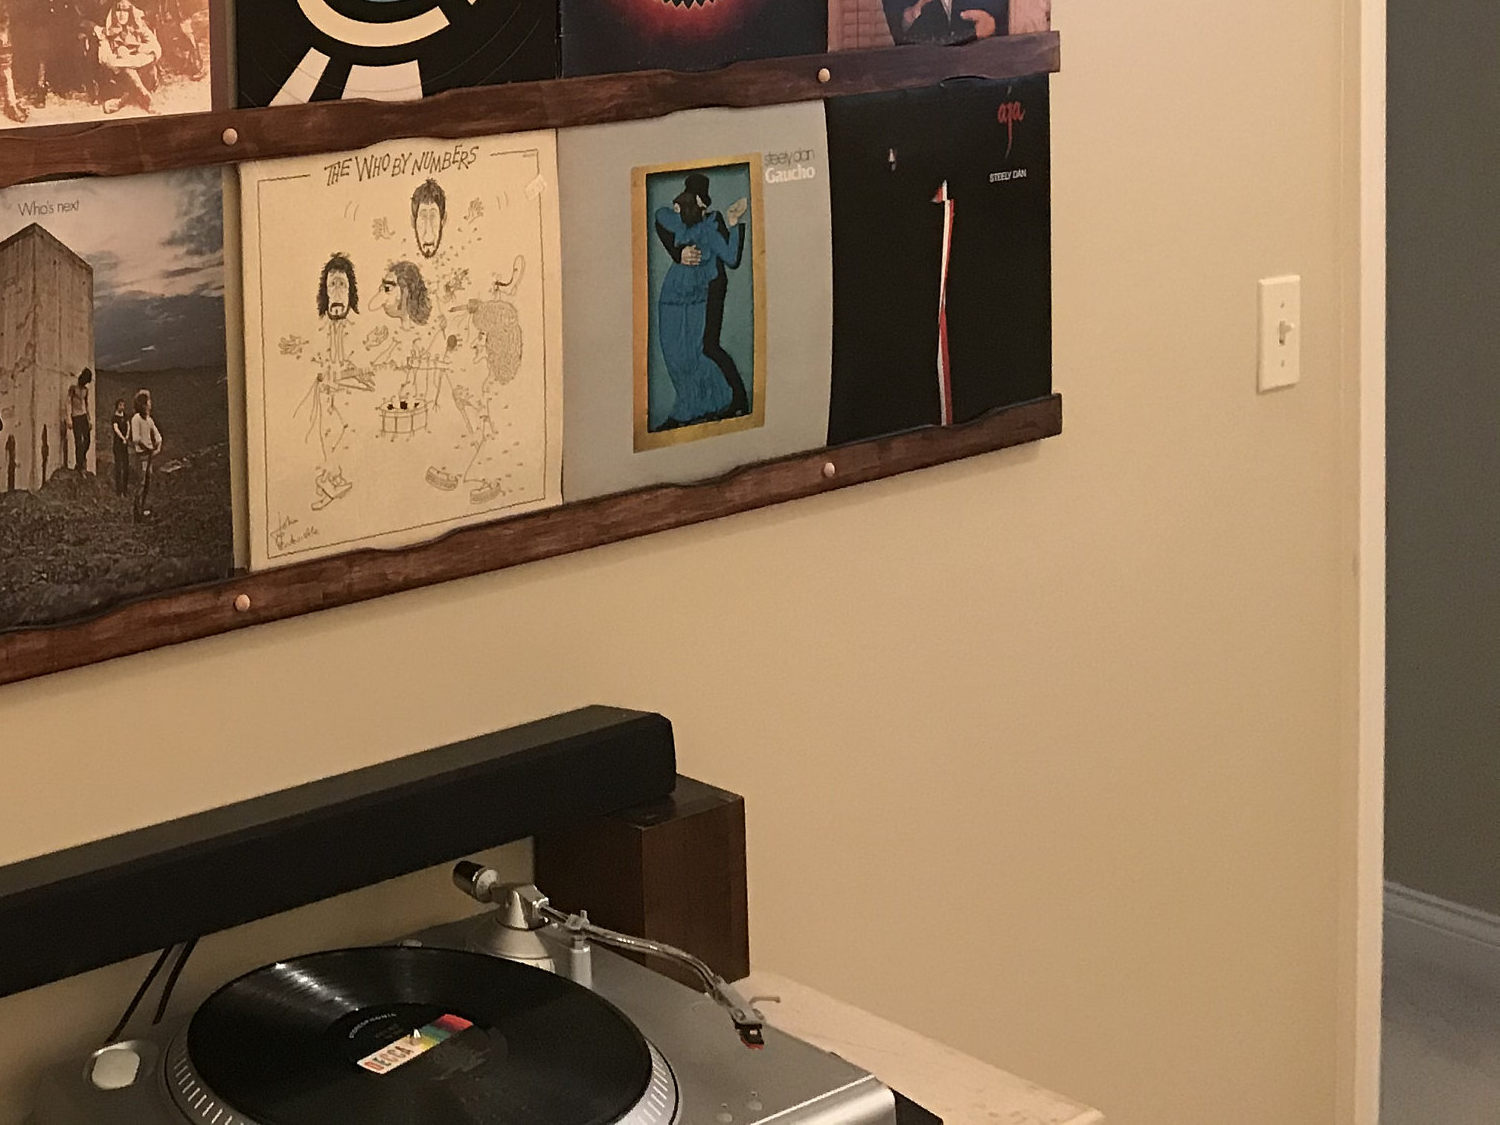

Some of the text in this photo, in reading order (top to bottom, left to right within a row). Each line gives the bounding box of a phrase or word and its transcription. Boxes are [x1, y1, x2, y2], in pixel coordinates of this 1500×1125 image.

[324, 144, 479, 186] THE WHO BY NUMBERS
[765, 164, 816, 183] Gaucho
[989, 169, 1027, 183] STEELY DAN
[18, 199, 79, 216] Who's next
[364, 1045, 415, 1072] DECCA
